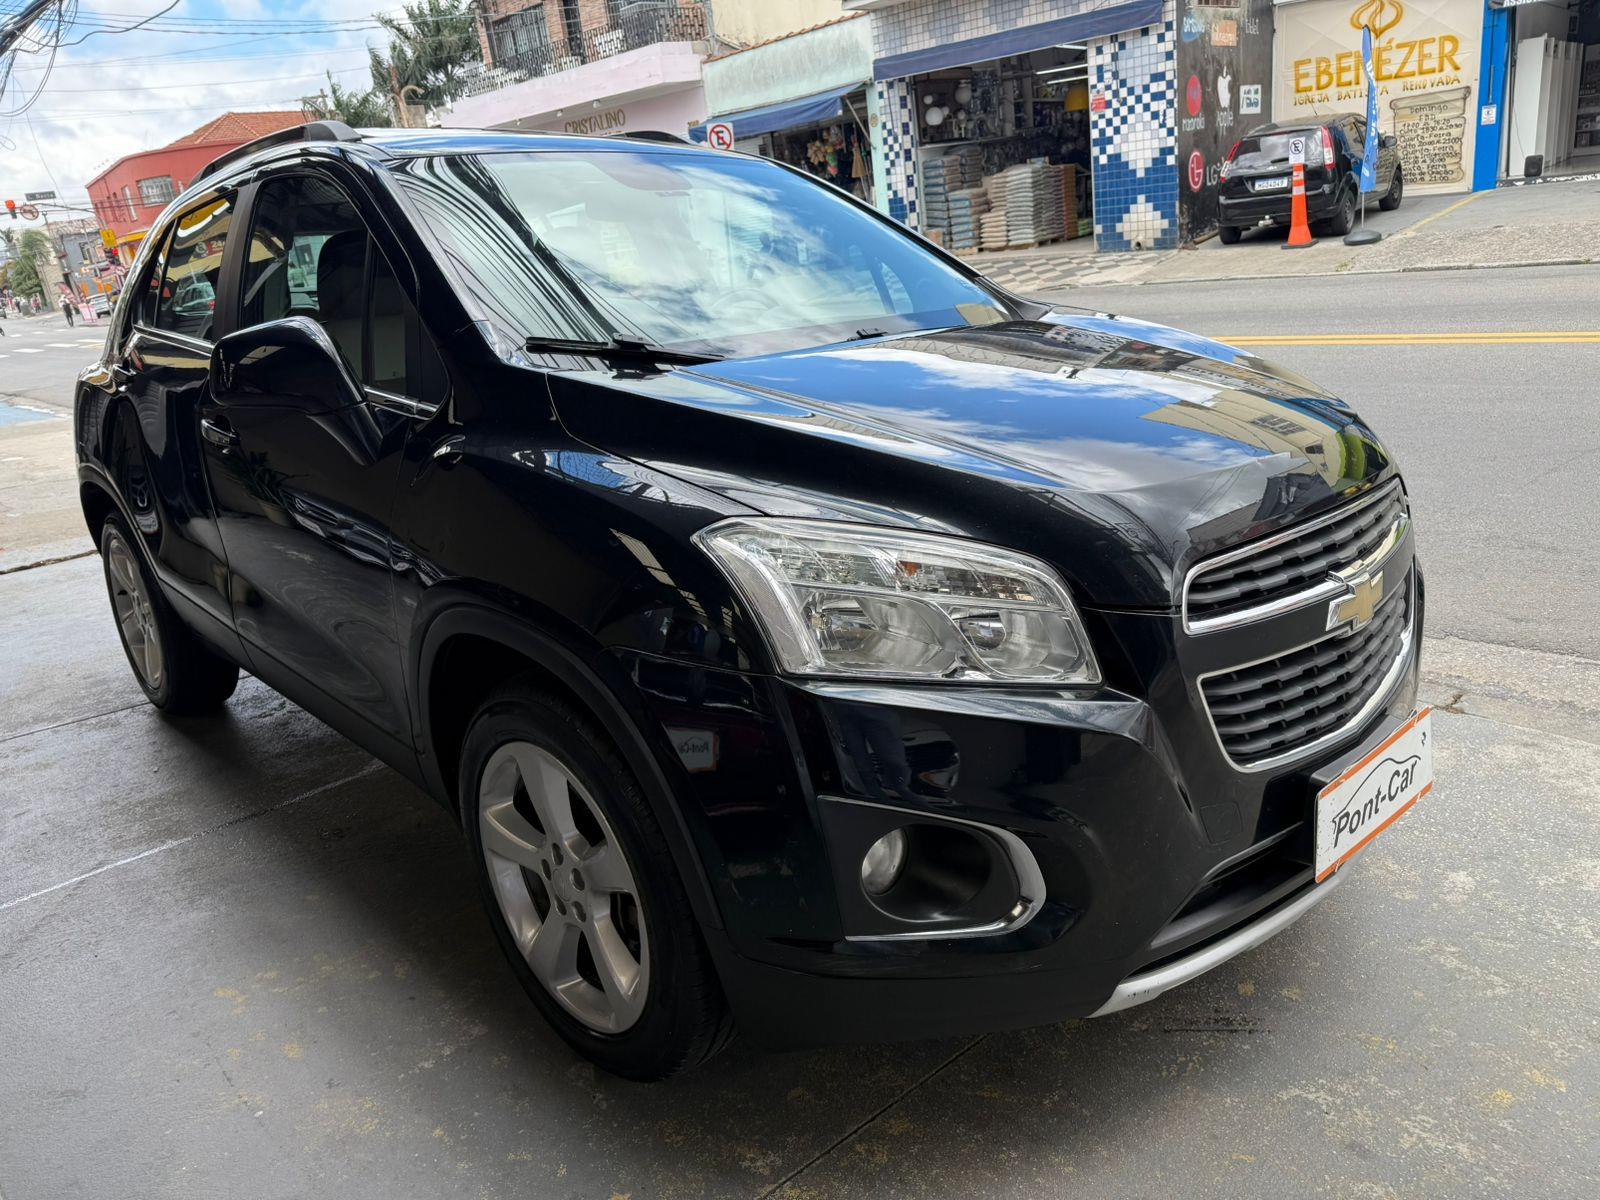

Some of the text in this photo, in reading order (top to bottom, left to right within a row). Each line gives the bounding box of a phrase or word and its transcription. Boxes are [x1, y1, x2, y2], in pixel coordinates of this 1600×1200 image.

[1338, 86, 1388, 101] BATIA
[1207, 165, 1218, 186] LG
[1334, 760, 1418, 848] Pont-Car
